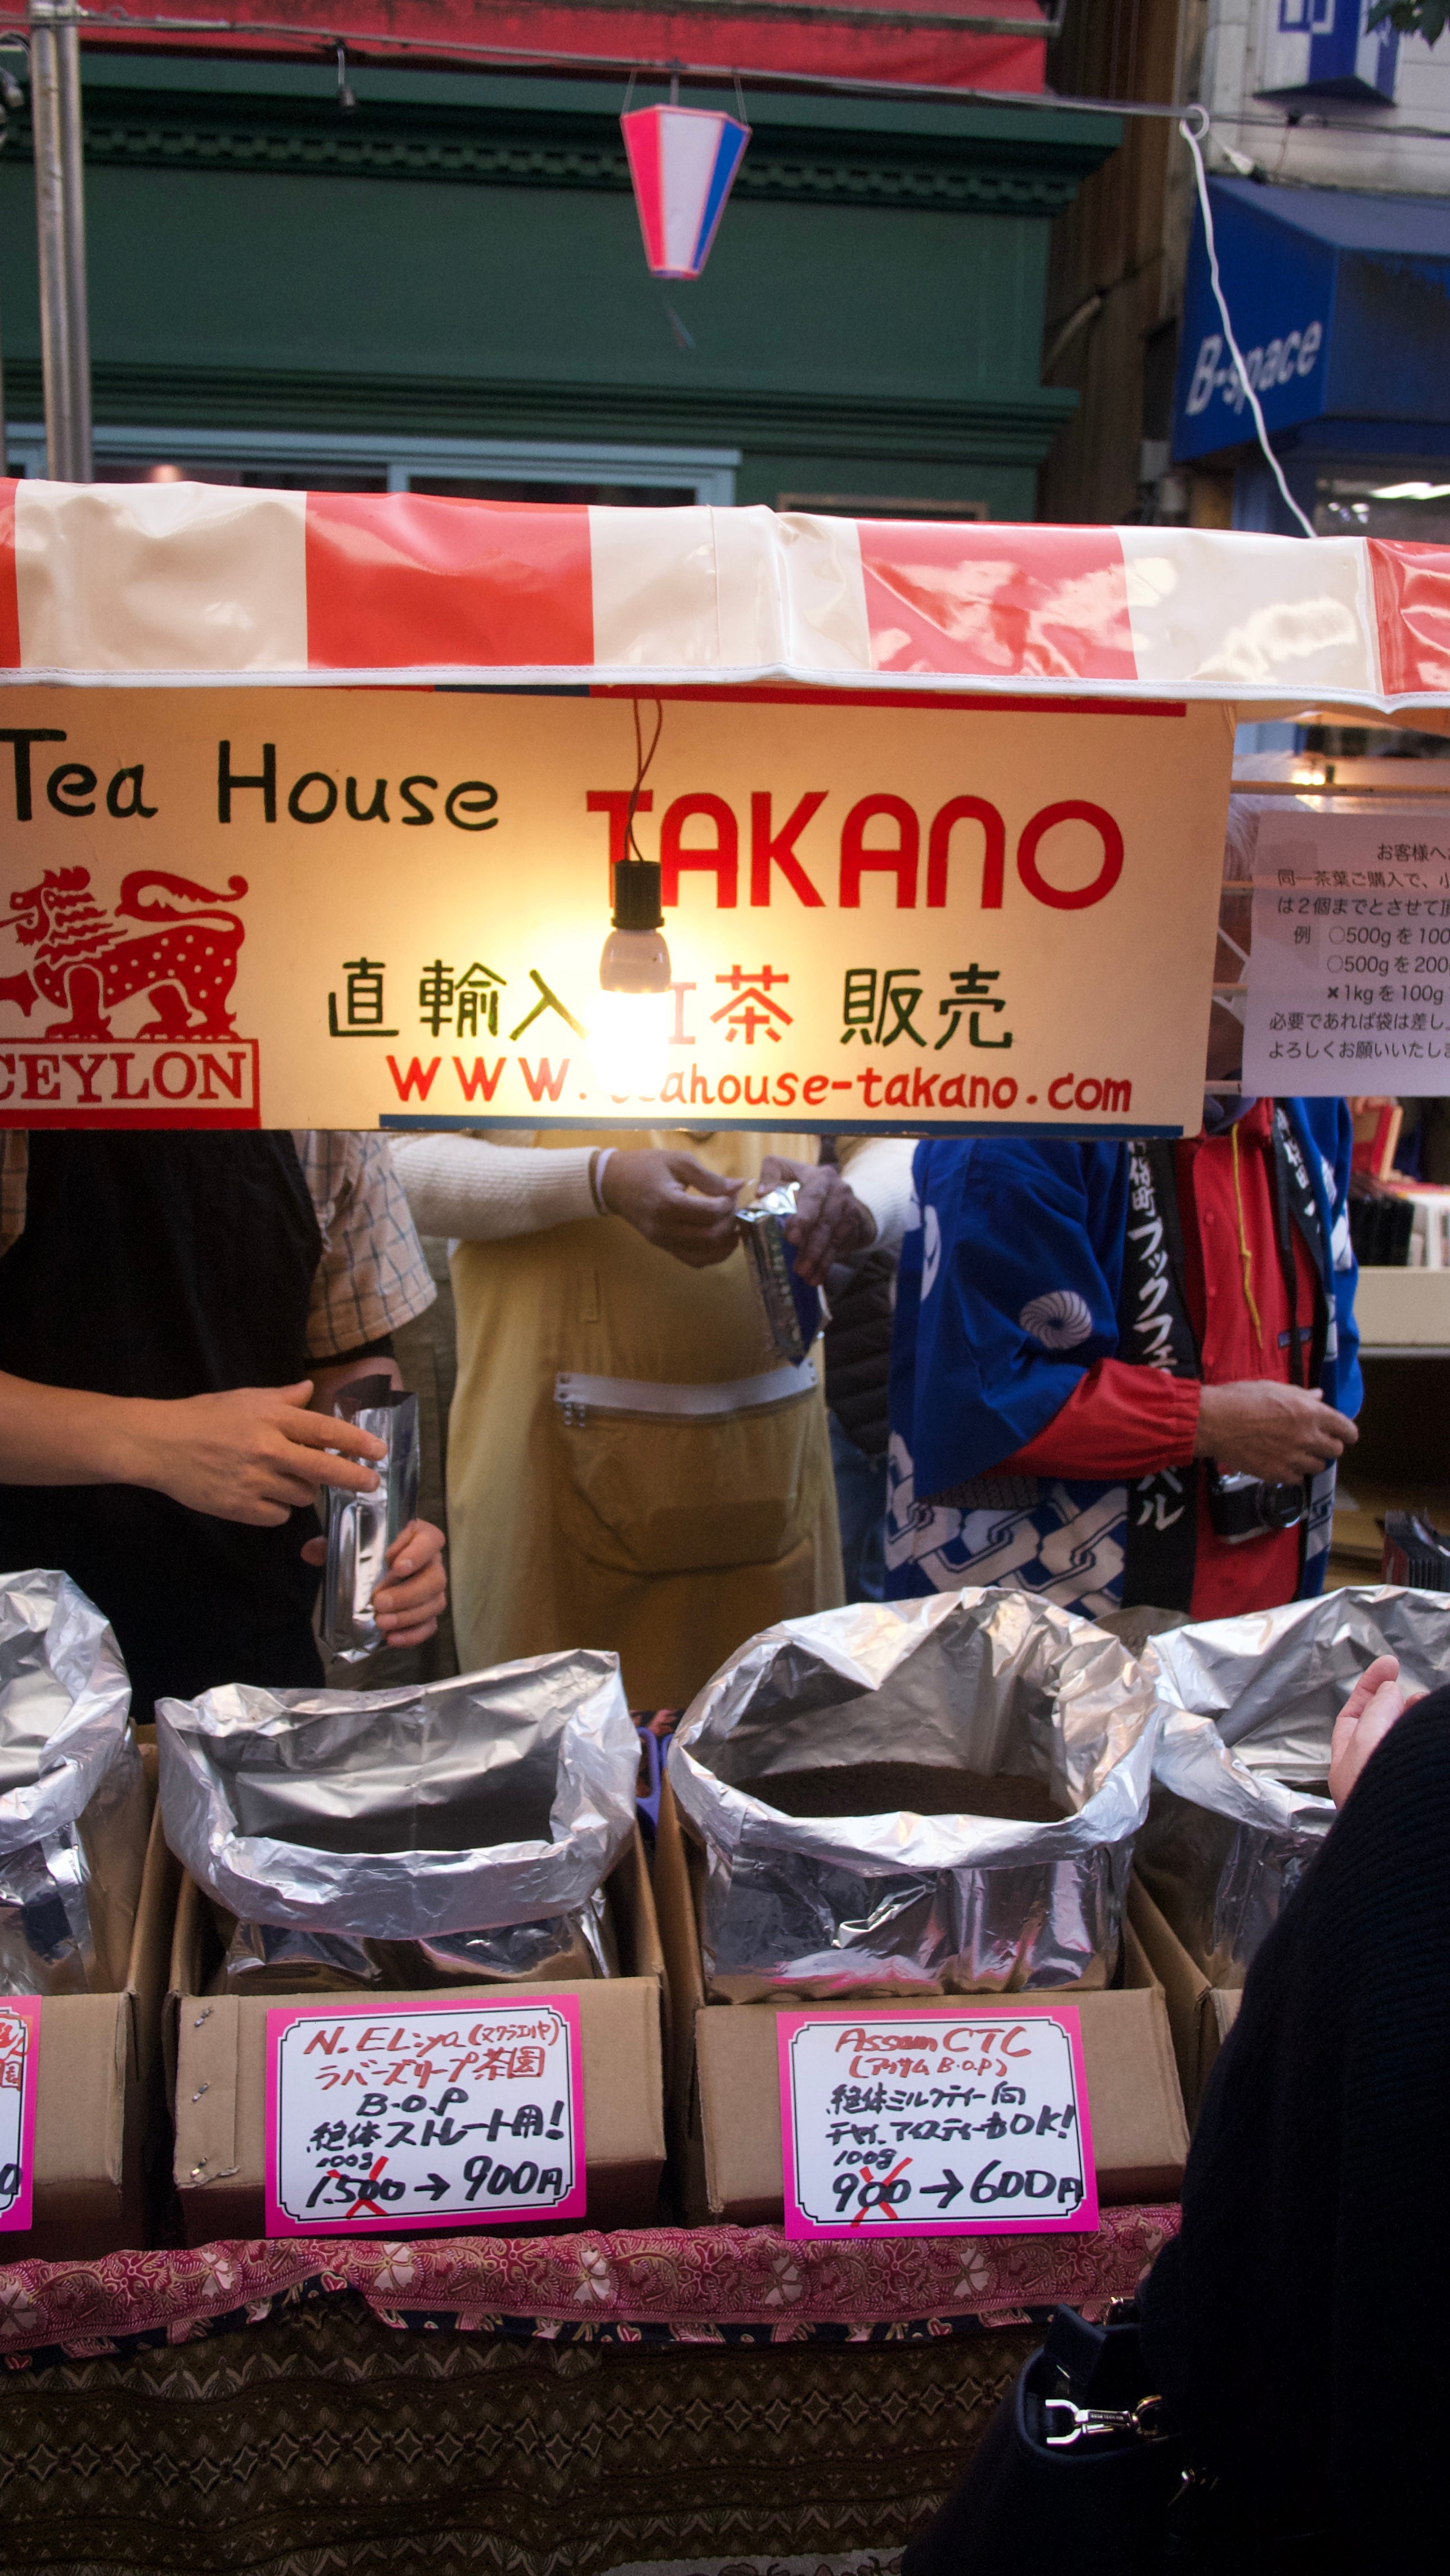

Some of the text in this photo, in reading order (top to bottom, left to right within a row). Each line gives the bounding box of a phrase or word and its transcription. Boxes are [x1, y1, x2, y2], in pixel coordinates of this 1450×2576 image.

[1185, 319, 1322, 417] B-space
[0, 728, 499, 831] Tea House
[587, 790, 1124, 910] TAKANO
[1377, 843, 1450, 863] お客様へ
[329, 958, 590, 1041] 直輸入
[840, 963, 1013, 1050] 販売
[1269, 1012, 1450, 1031] 必要であれば袋は差し
[942, 2025, 1032, 2058] CTC
[832, 2172, 911, 2212] 900
